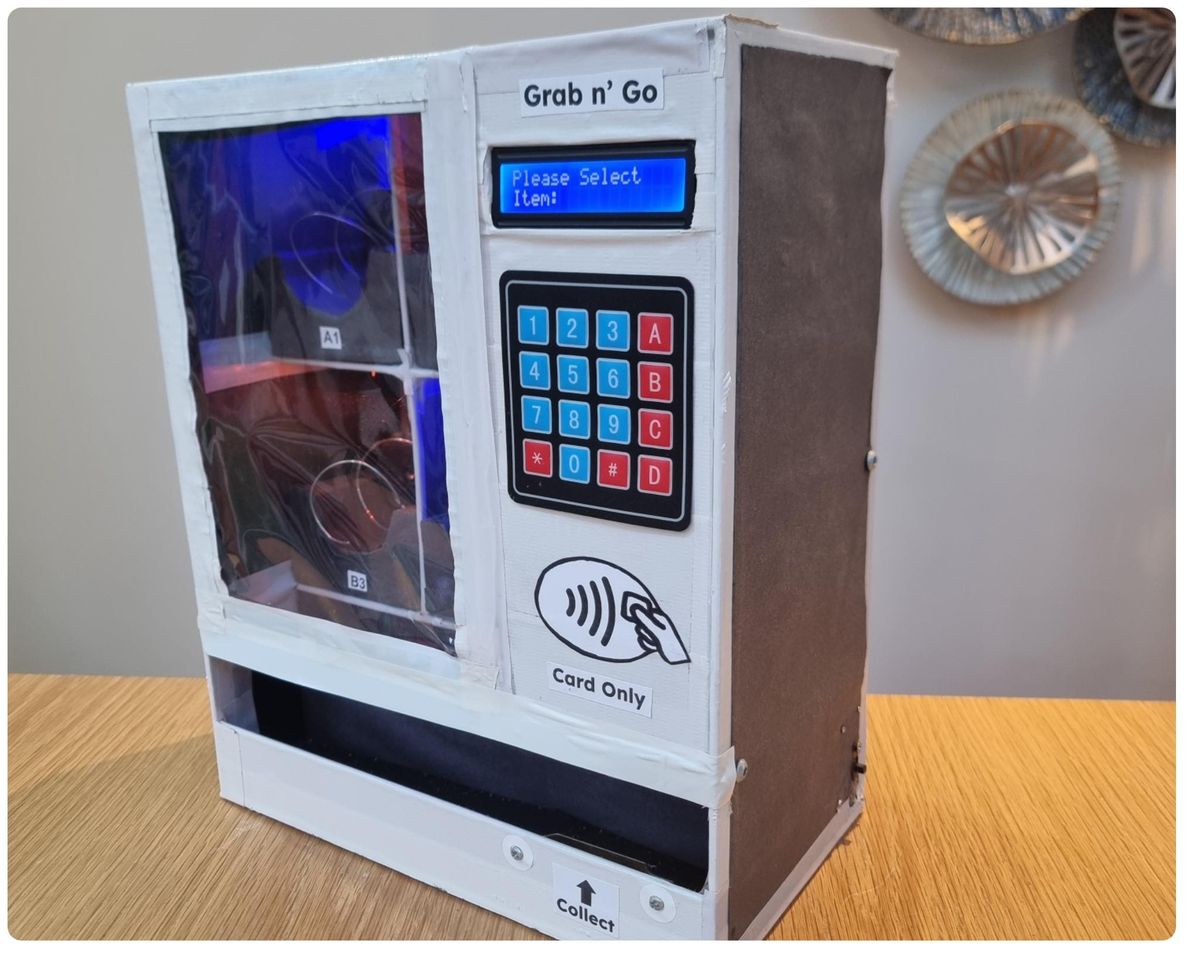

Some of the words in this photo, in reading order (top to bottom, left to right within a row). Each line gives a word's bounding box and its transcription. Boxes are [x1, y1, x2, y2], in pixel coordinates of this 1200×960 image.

[524, 82, 583, 107] Grab
[622, 79, 658, 104] Go
[512, 170, 570, 188] Please
[579, 167, 642, 186] Select
[513, 190, 557, 208] Item:
[322, 332, 340, 344] A1
[529, 315, 537, 335] 1
[567, 318, 578, 339] 2
[607, 320, 618, 341] 3
[649, 323, 662, 345] A
[530, 361, 540, 381] 4
[568, 365, 578, 385] 5
[608, 368, 619, 389] 6
[649, 371, 662, 393] B
[531, 406, 541, 425] 7
[569, 409, 579, 429] 8
[608, 413, 619, 434] 9
[649, 418, 661, 440] C
[569, 454, 580, 474] 0
[649, 464, 661, 486] D
[350, 575, 367, 588] B3
[552, 667, 595, 693] Card
[602, 680, 646, 711] Only
[556, 897, 615, 933] Collect
